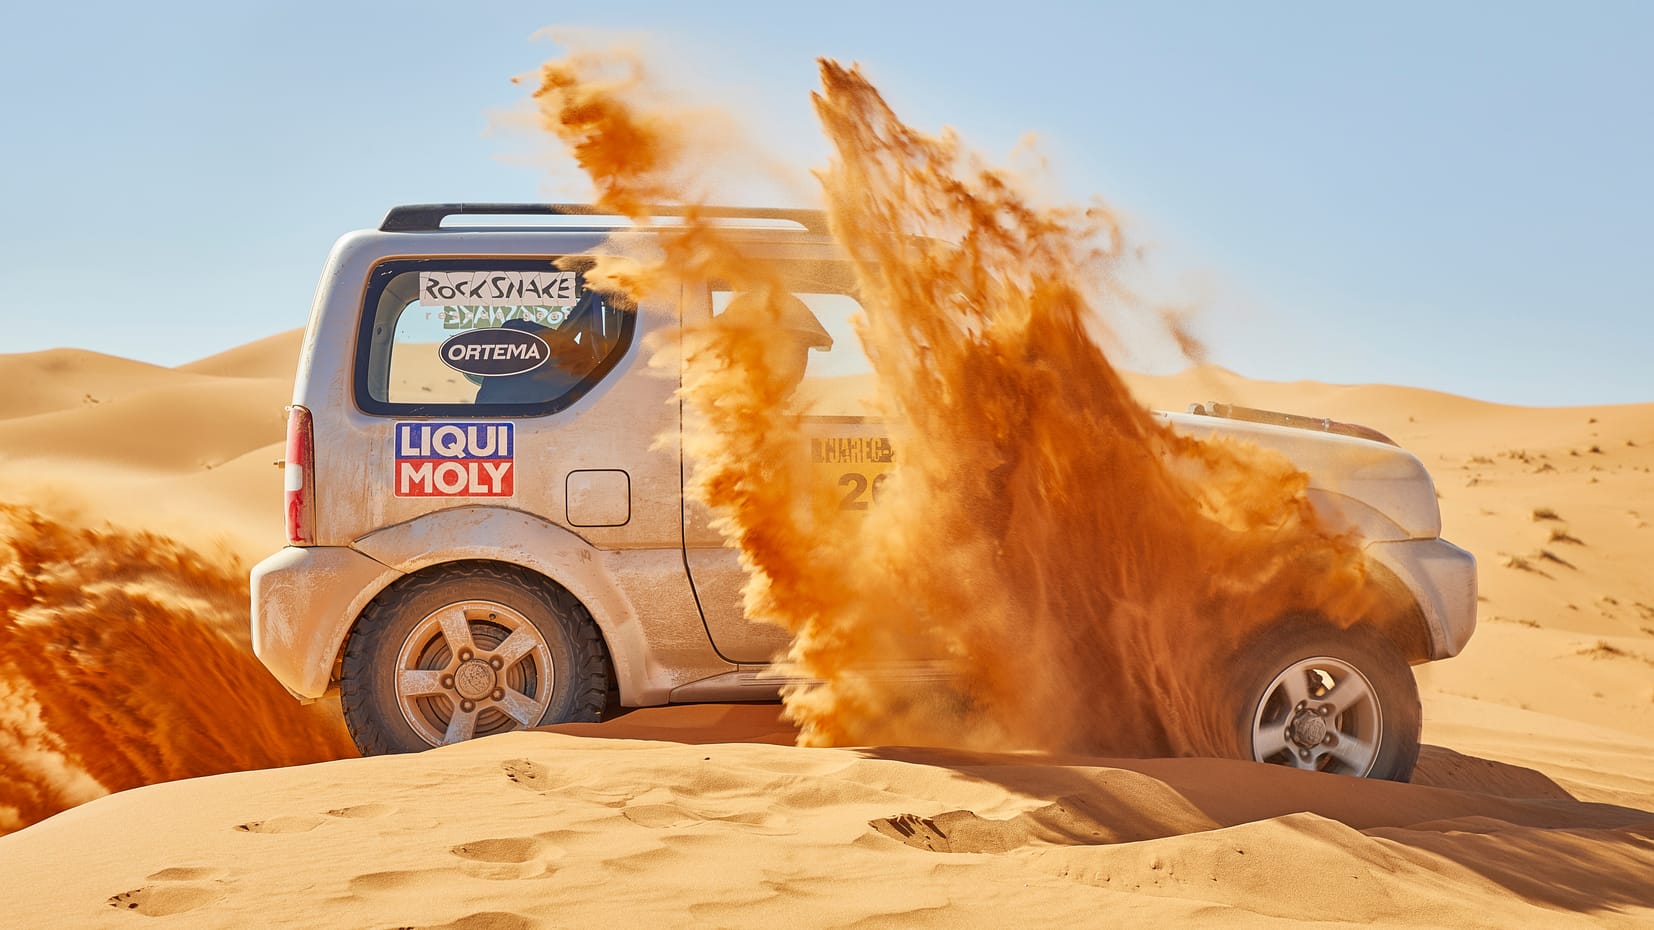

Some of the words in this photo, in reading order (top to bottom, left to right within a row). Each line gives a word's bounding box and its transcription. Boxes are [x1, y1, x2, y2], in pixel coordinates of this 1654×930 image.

[448, 343, 541, 361] ORTEMA
[401, 425, 508, 458] LIQUI
[401, 461, 512, 494] MOLY
